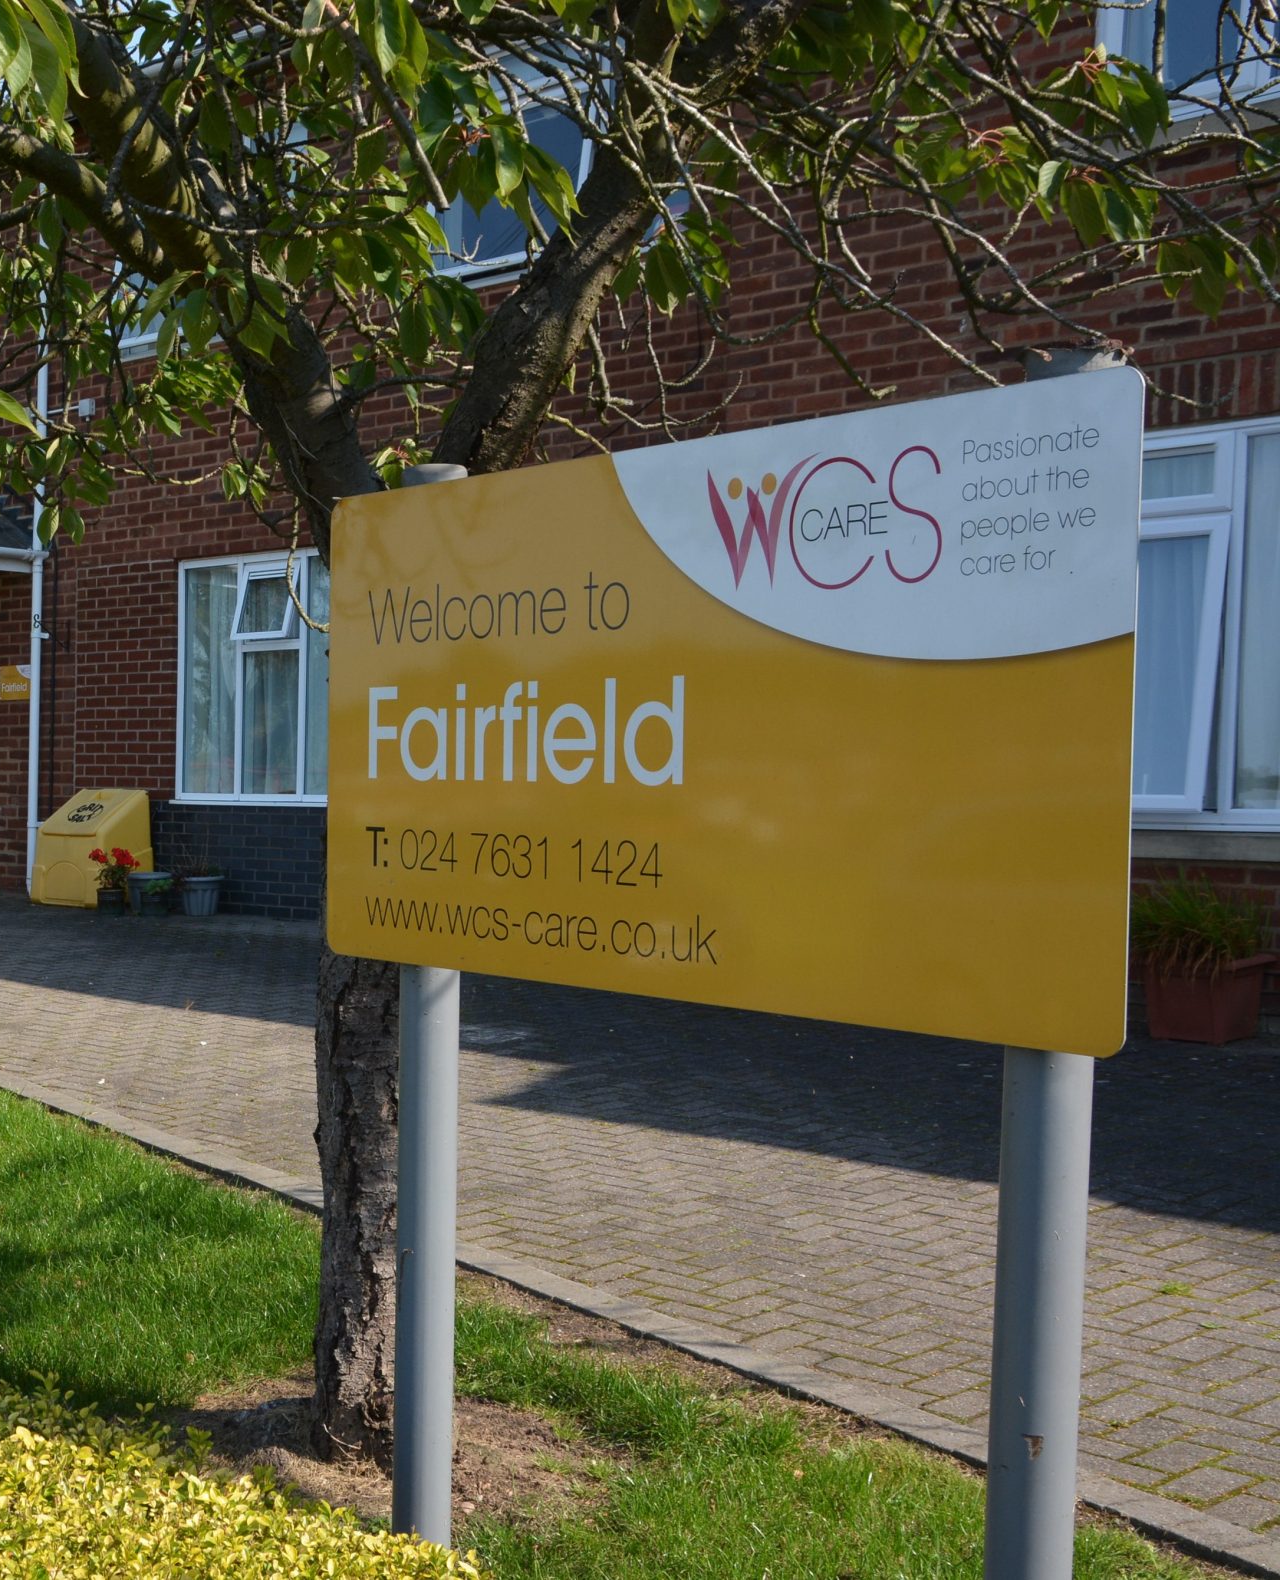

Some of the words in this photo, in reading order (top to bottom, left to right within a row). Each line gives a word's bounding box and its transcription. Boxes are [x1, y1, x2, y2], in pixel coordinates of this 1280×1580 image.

[962, 423, 1100, 465] Passionate
[961, 473, 1038, 503] about
[1046, 466, 1090, 494] the
[800, 500, 889, 542] CARE
[960, 508, 1050, 546] people
[1057, 504, 1097, 529] we
[959, 554, 1016, 576] care
[1022, 546, 1056, 570] for
[368, 583, 567, 646] Welcome
[583, 571, 630, 631] to
[1, 683, 27, 693] Fairfield
[368, 675, 685, 787] Fairfield
[365, 826, 389, 868] T:
[399, 828, 458, 873] 024
[470, 832, 549, 880] 7631
[571, 838, 663, 889] 1424
[365, 896, 718, 965] www.wcs-care.co.uk
